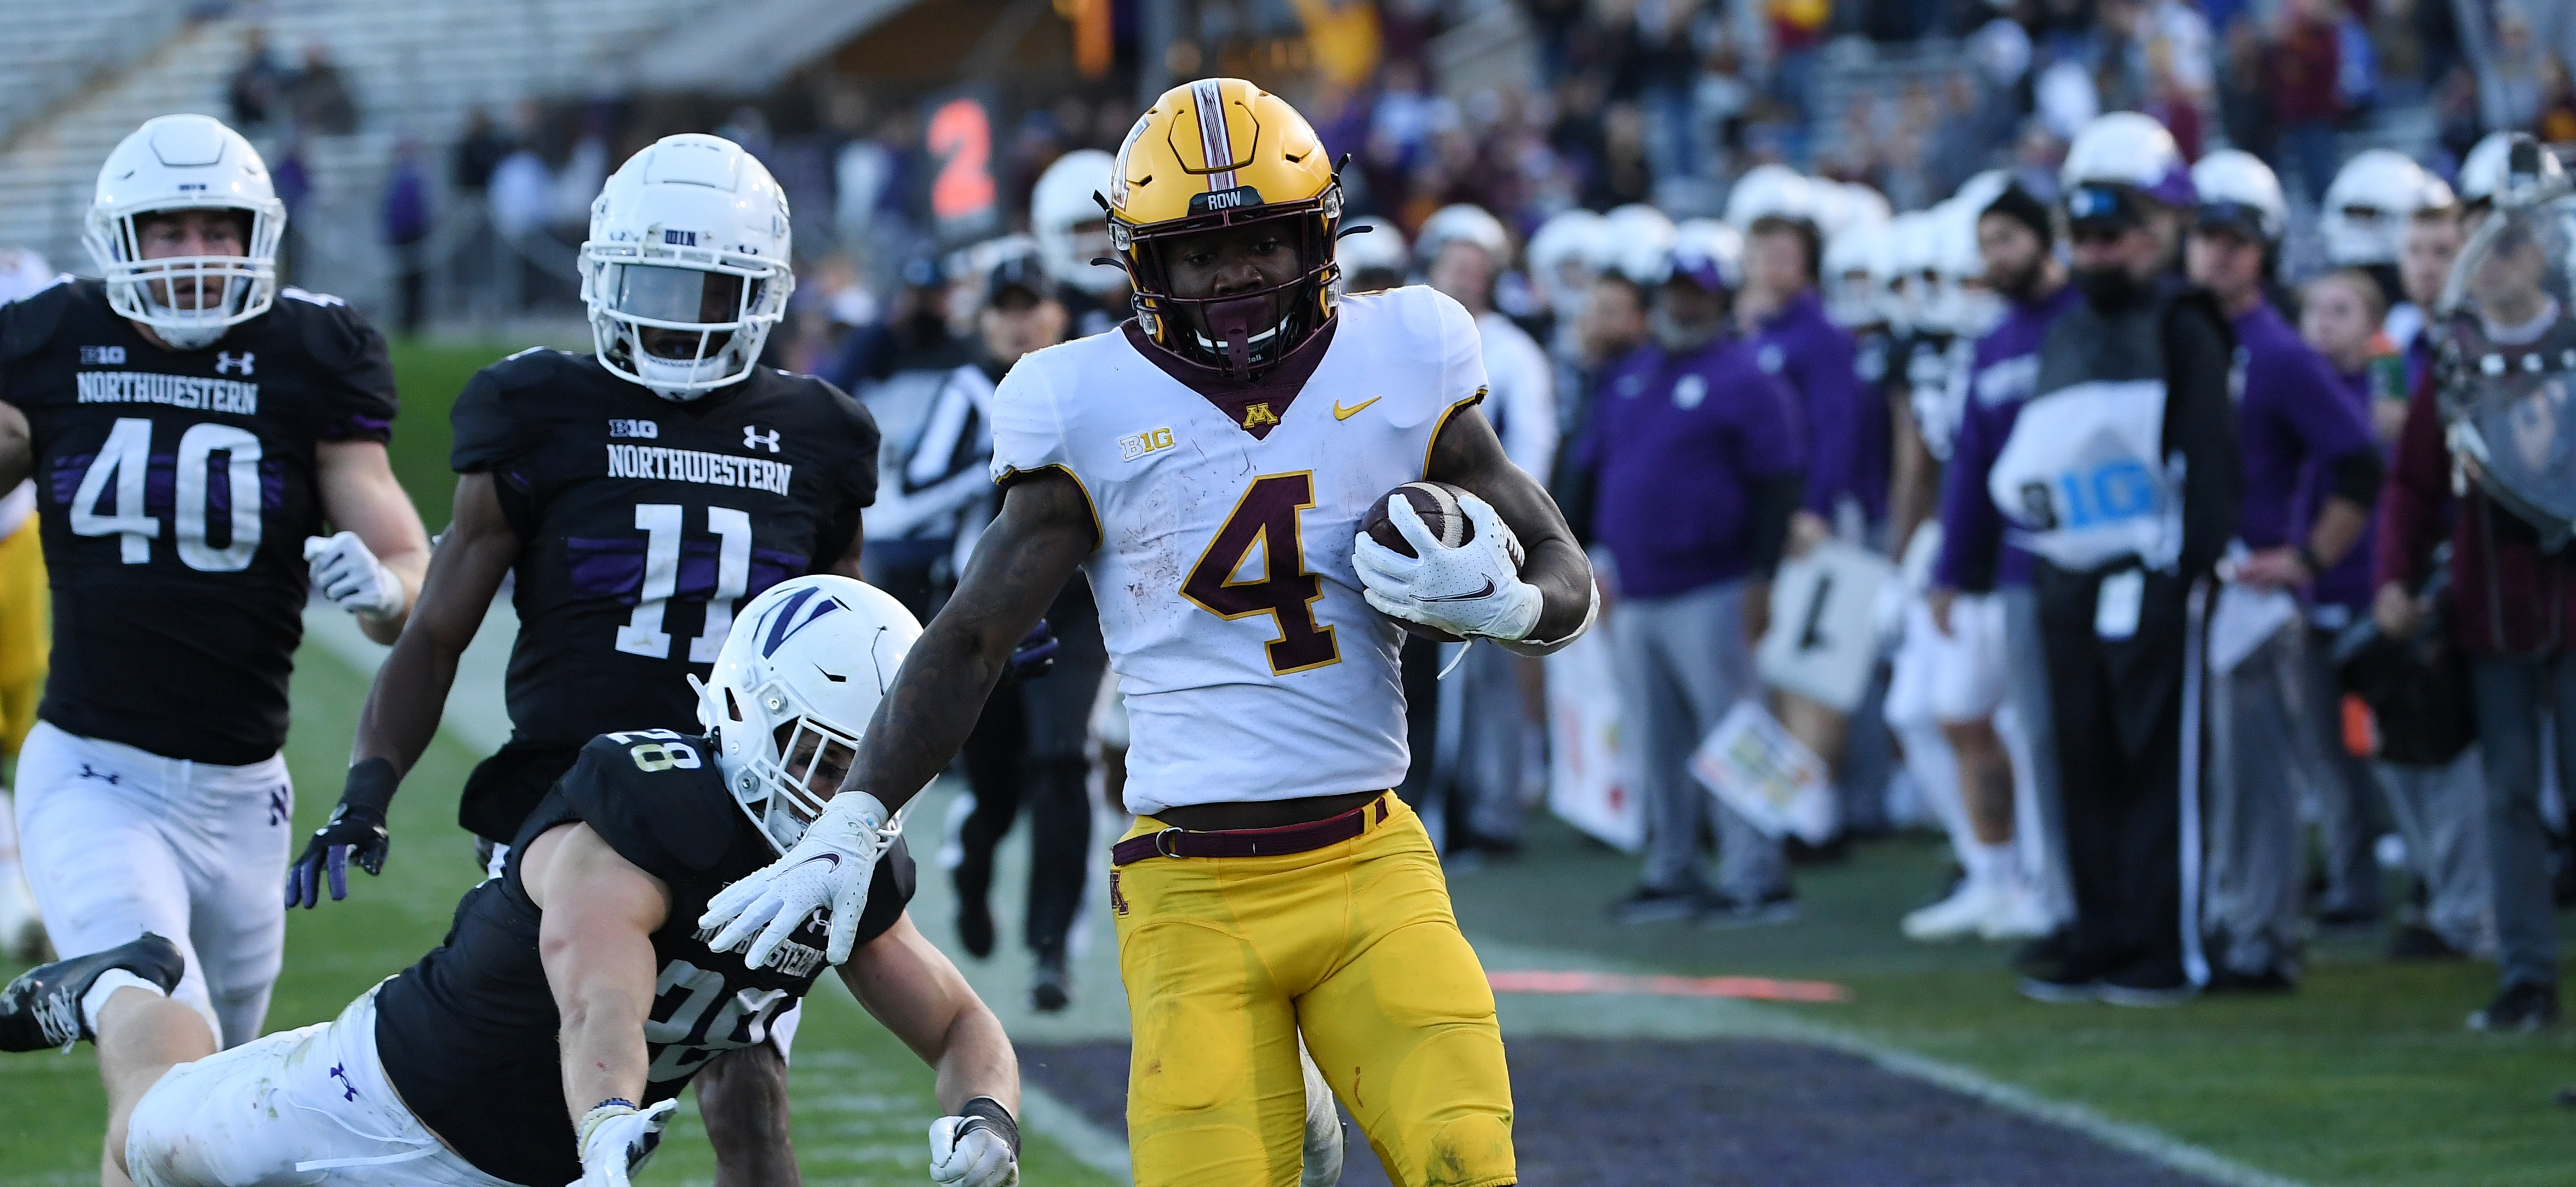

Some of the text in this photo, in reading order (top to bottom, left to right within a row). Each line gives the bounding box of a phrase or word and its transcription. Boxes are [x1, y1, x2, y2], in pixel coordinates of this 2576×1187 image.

[928, 98, 996, 219] 2
[1207, 191, 1242, 210] ROW
[77, 372, 257, 415] NORTHWESTERN
[1242, 402, 1278, 429] M
[1120, 427, 1174, 461] B1G
[70, 417, 263, 571] 40
[606, 444, 793, 496] NORTHWESTERN
[615, 503, 753, 663] 11
[1178, 469, 1342, 677] 4
[605, 727, 702, 772] 28
